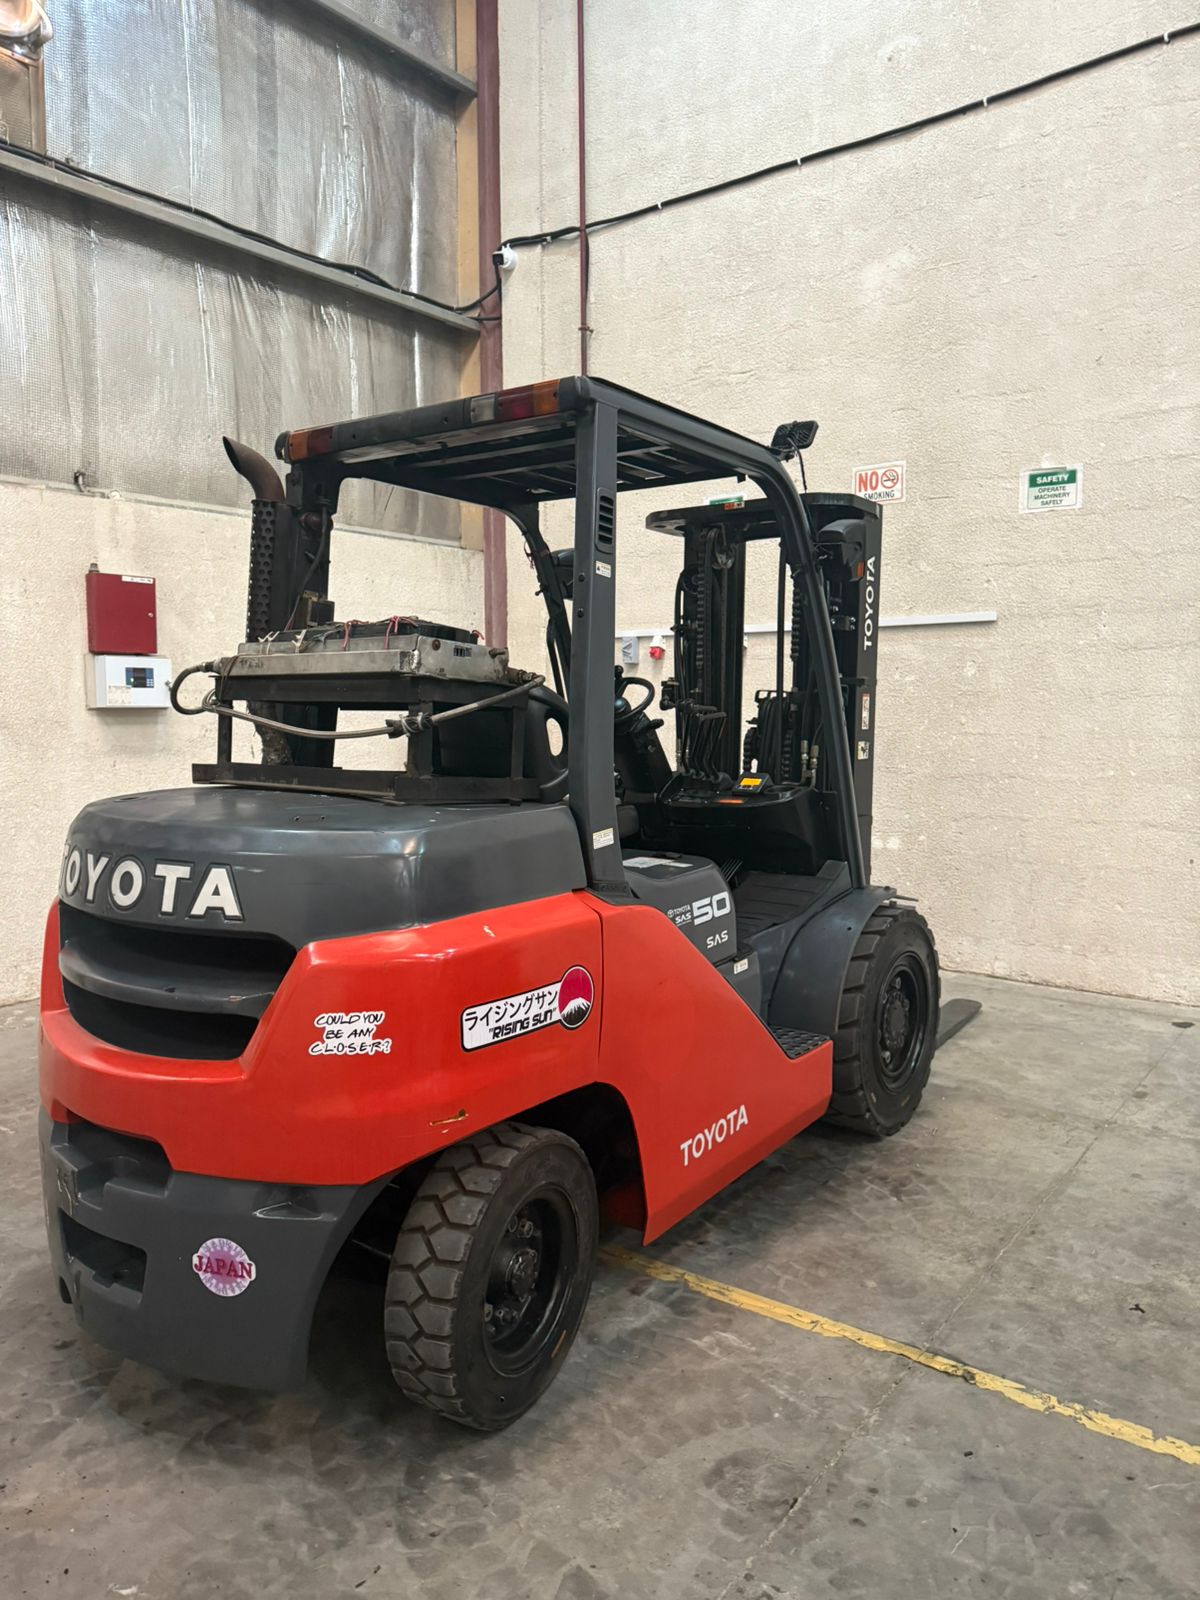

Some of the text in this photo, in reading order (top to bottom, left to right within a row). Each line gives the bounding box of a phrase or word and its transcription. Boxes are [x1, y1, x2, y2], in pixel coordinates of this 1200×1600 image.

[858, 470, 879, 492] NO
[1036, 473, 1069, 484] SAFETY
[863, 490, 895, 500] SMOKING
[1034, 492, 1070, 500] MACHINERY
[863, 556, 876, 651] TOYOTA
[65, 845, 242, 916] OYOTA
[674, 891, 731, 926] TOYOTA 50
[675, 912, 692, 924] SAS
[706, 930, 728, 949] SAS
[316, 1013, 383, 1025] COULD YOU
[464, 989, 558, 1031] ライジングサン
[326, 1027, 374, 1039] BE ANY
[680, 1104, 749, 1167] TOYOTA
[194, 1255, 253, 1280] JAPAN
